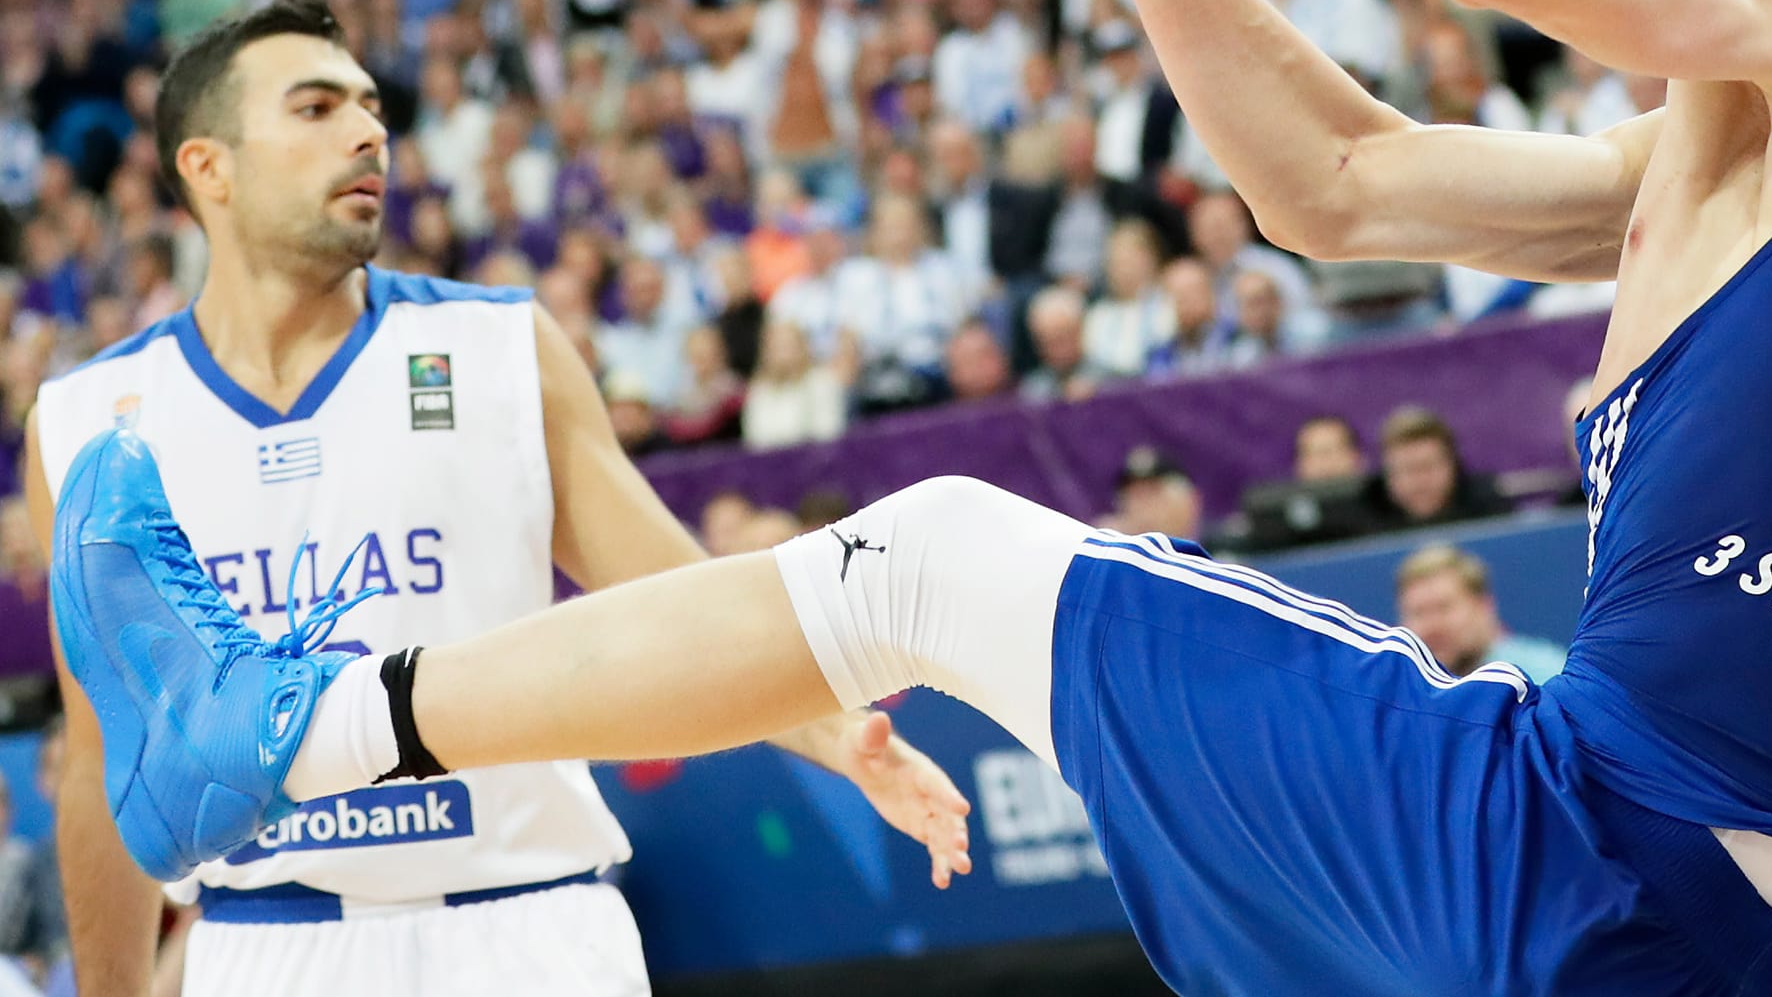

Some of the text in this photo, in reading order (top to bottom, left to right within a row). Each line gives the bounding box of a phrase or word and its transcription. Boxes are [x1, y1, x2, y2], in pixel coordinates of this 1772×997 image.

[204, 528, 443, 617] ELLAS
[1693, 534, 1746, 576] 3
[256, 790, 455, 849] urobank
